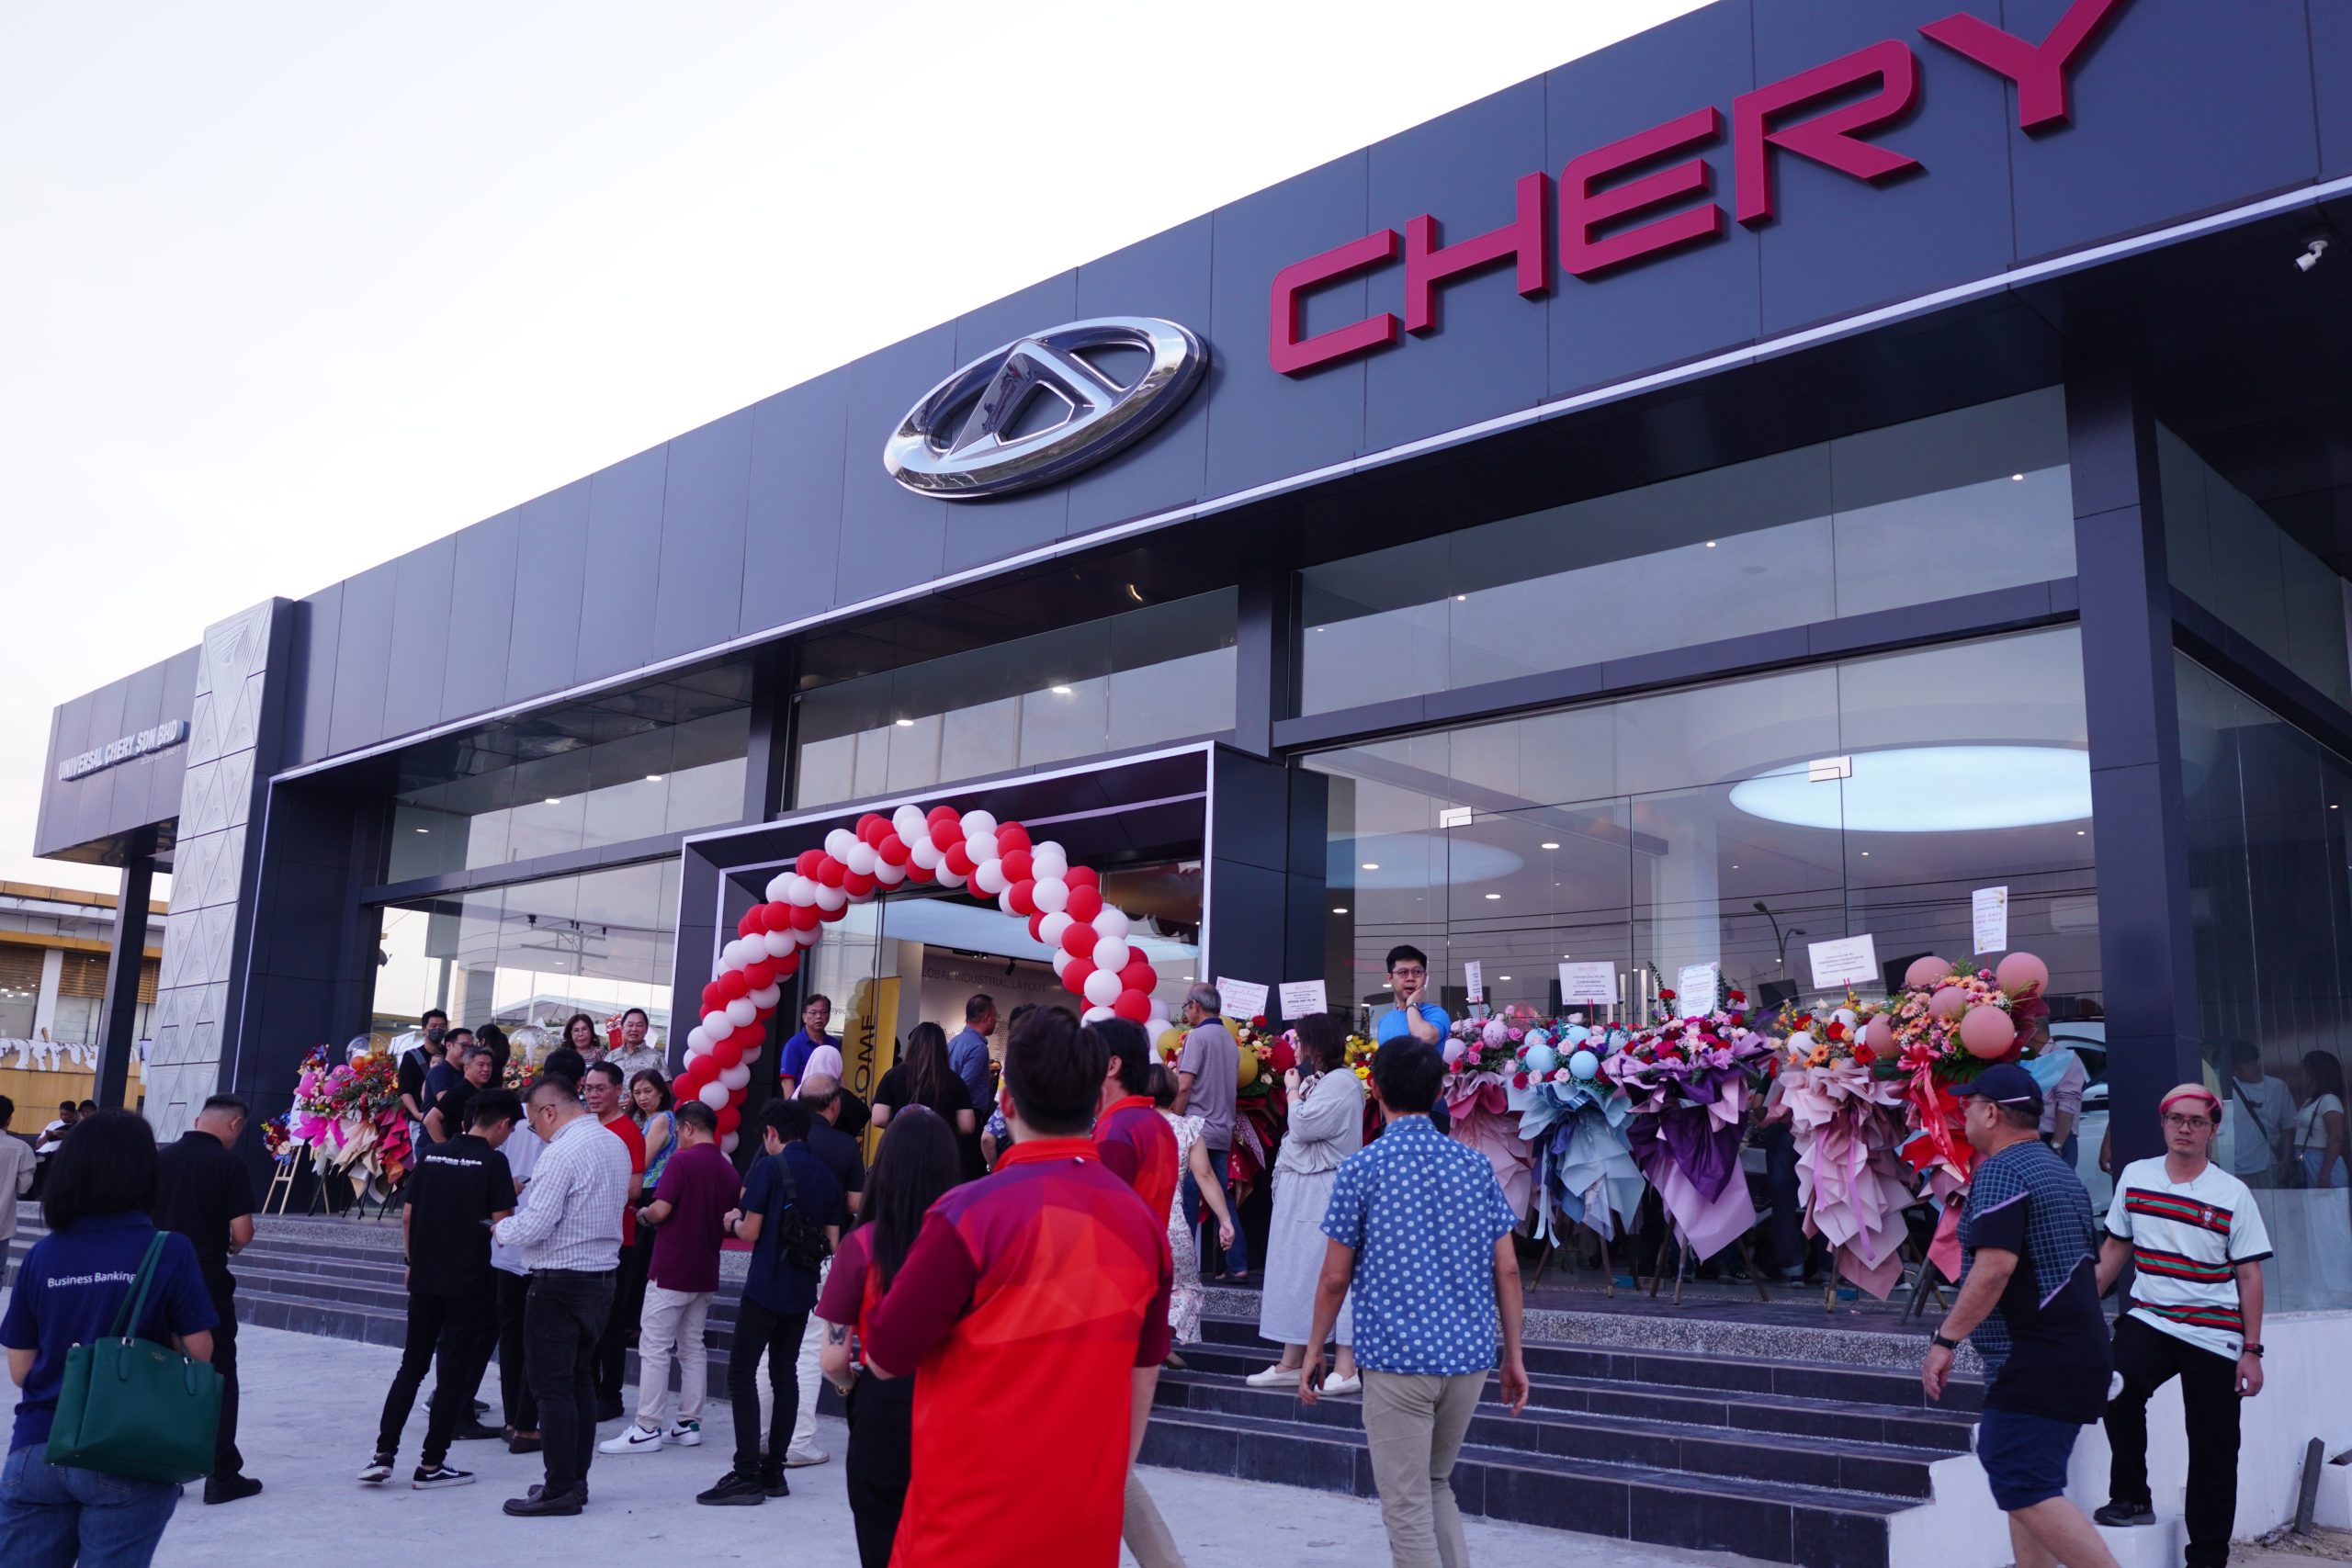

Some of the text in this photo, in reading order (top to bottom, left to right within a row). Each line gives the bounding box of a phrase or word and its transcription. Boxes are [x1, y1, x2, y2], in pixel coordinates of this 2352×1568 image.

[1269, 0, 2124, 375] CHERY
[58, 747, 104, 781] UNIVERSAL
[105, 734, 136, 763] CHERY
[135, 727, 157, 753] SDN
[156, 719, 178, 743] BHD
[922, 968, 1046, 993] LOBAL INDUSTRIAL LAYOUT
[47, 1271, 137, 1288] Business Banking
